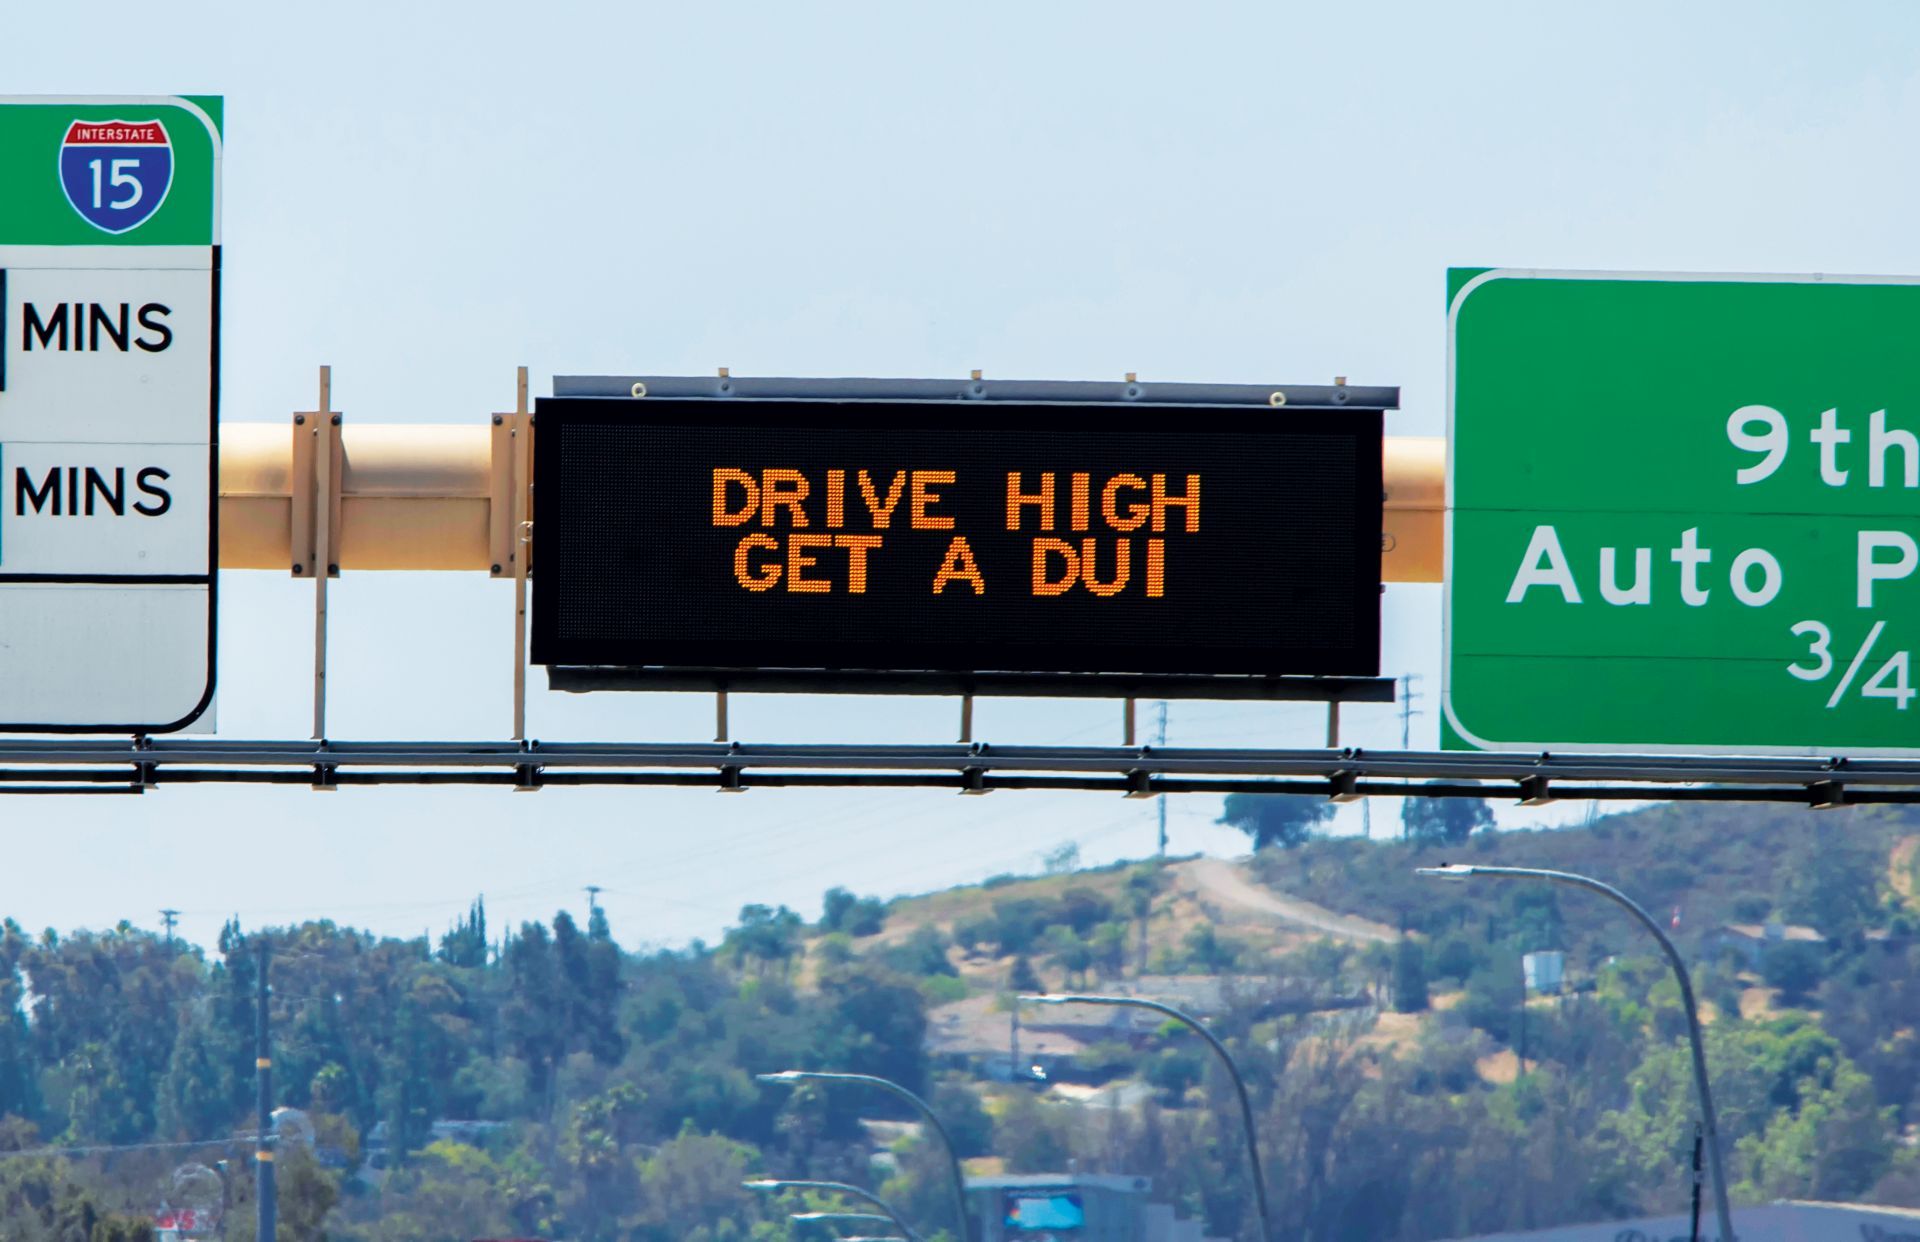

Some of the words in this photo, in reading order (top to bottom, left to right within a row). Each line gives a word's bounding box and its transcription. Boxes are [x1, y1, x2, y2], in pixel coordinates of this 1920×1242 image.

[77, 128, 155, 141] INTERSTATE
[89, 159, 143, 210] 15
[23, 302, 173, 353] MINS
[1726, 405, 1920, 487] 9th
[15, 467, 172, 517] MINS
[712, 468, 956, 529] DRIVE
[1006, 472, 1201, 532] HIGH
[734, 533, 883, 593] GET
[932, 536, 985, 595] A
[1032, 537, 1165, 597] DUI
[1505, 525, 1783, 607] Auto
[1857, 530, 1919, 608] P
[1786, 620, 1917, 710] 3/4
